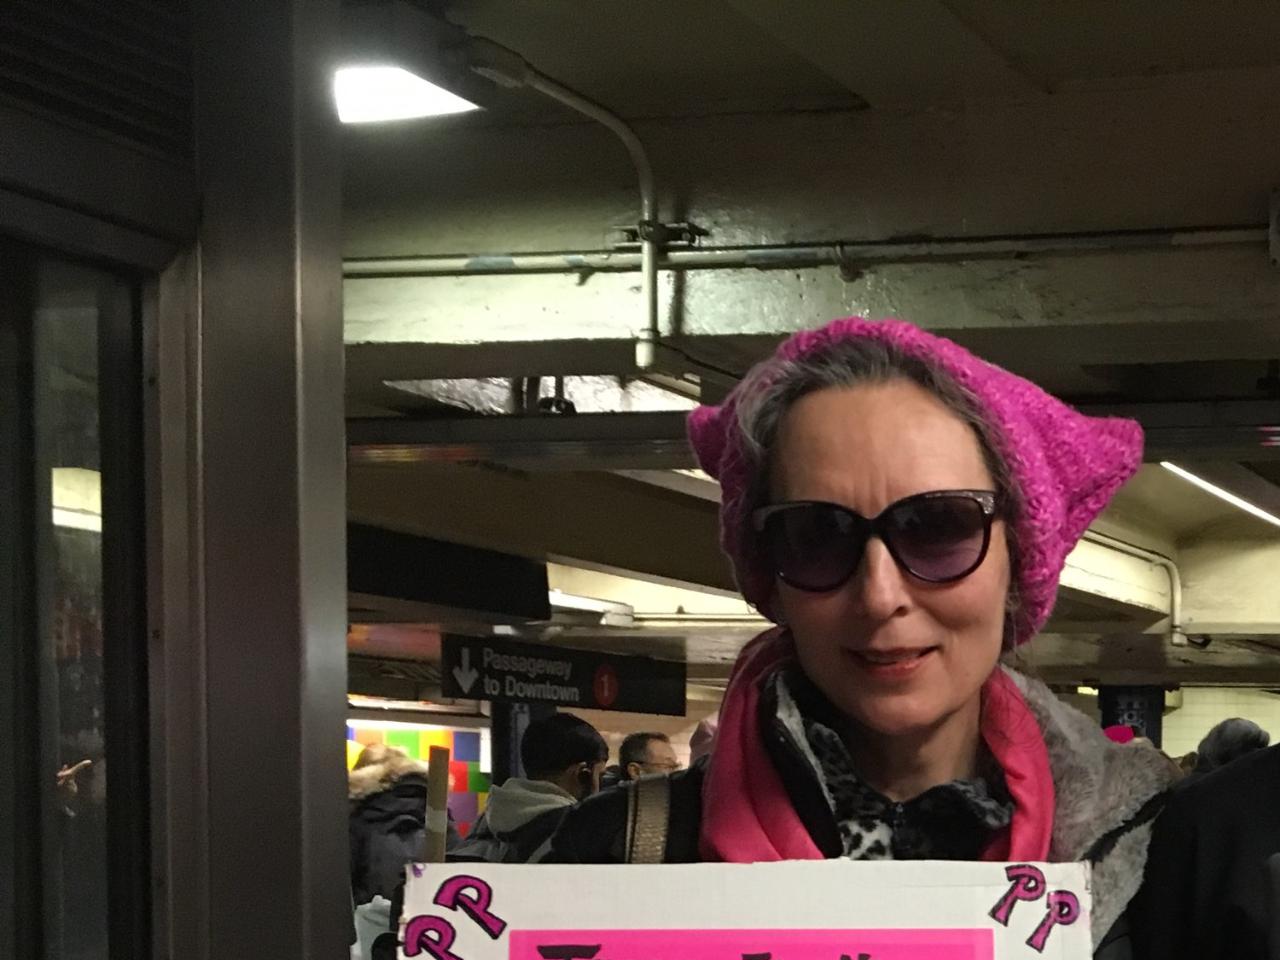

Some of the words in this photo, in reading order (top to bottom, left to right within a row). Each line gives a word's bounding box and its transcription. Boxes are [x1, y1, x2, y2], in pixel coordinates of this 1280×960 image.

[482, 648, 573, 680] Passageway
[483, 673, 500, 696] to
[505, 676, 580, 701] Downtown
